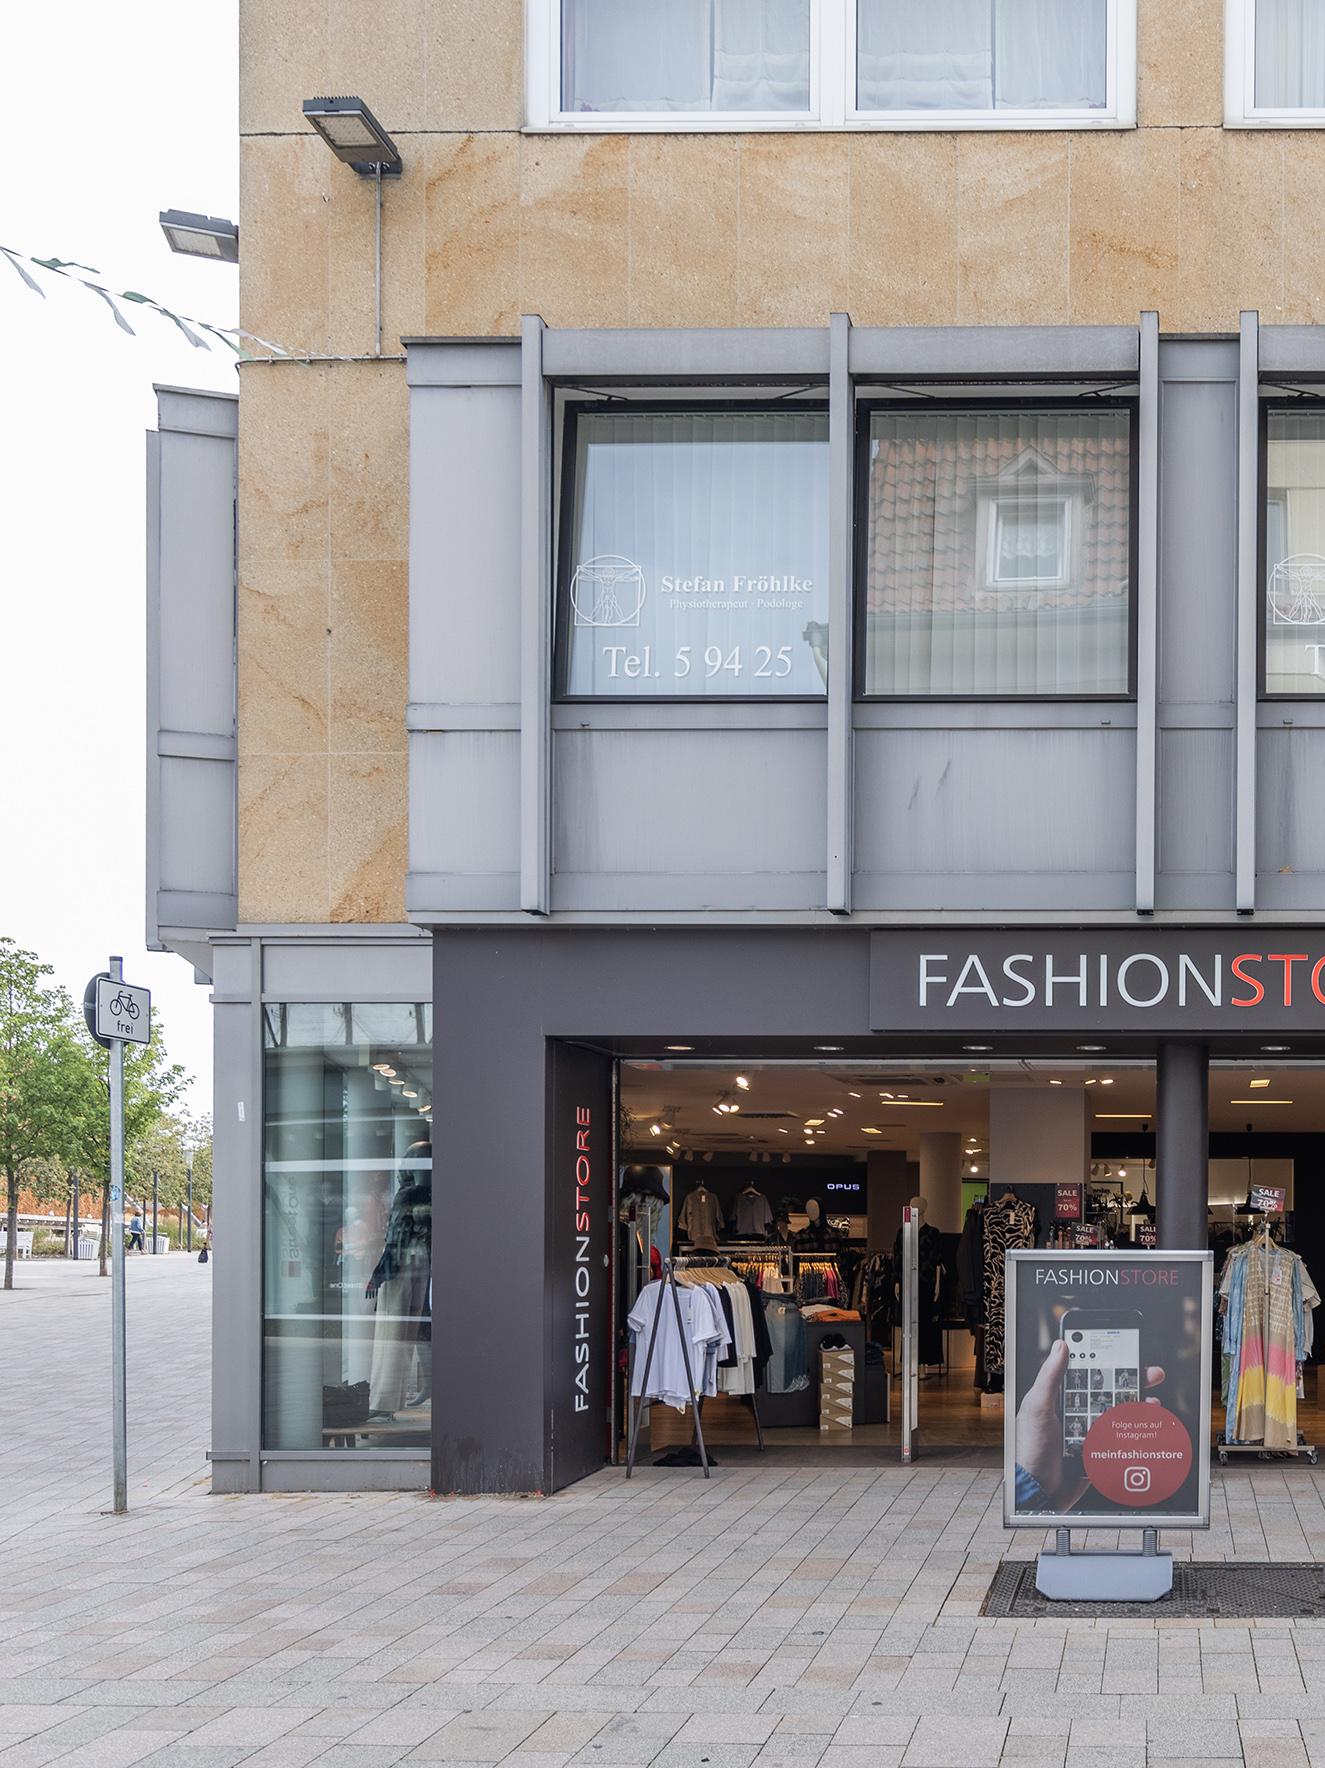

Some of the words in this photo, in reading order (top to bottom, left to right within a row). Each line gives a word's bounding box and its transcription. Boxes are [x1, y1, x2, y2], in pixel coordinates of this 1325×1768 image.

[661, 575, 724, 593] Stefan
[732, 575, 813, 593] Fröhlke
[669, 598, 748, 610] Physiotherapeut
[756, 598, 803, 610] Podologe
[602, 646, 660, 678] Tel.
[673, 646, 692, 678] 5
[704, 646, 743, 678] 94
[753, 646, 793, 678] 25
[117, 1020, 134, 1035] frei
[826, 1183, 860, 1191] OPUS
[1057, 1189, 1078, 1197] SALE
[1259, 1188, 1280, 1197] SALE
[1057, 1203, 1078, 1211] 70%
[1076, 1225, 1093, 1233] SALE
[575, 1105, 592, 1413] FASHIONSTORE
[1035, 1268, 1179, 1286] FASHIONSTORE
[1111, 1421, 1132, 1430] Folge
[1149, 1421, 1163, 1429] auf
[1116, 1431, 1158, 1440] Instagram!
[1090, 1449, 1183, 1460] meinfashionstore
